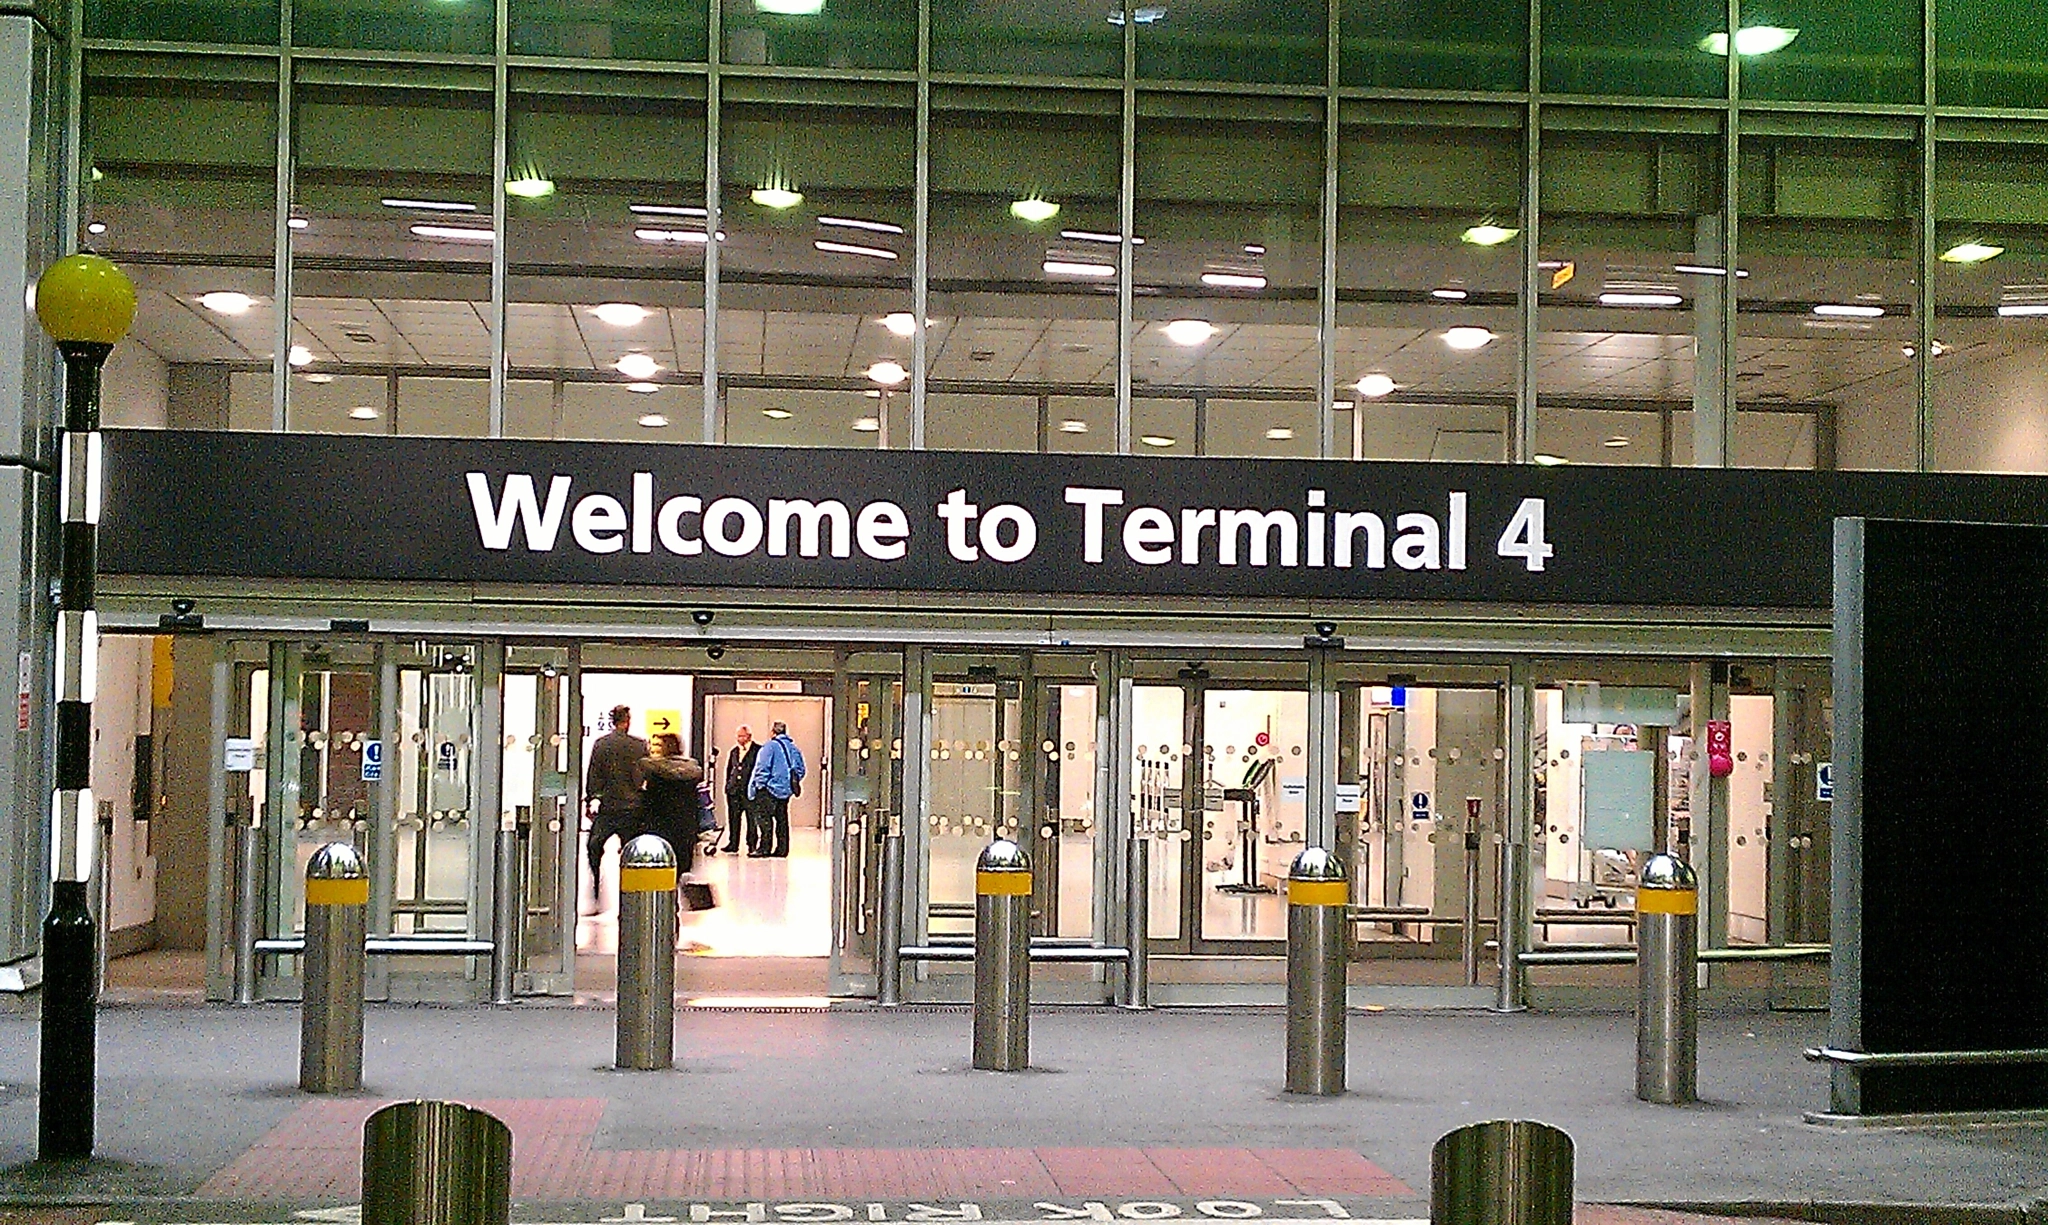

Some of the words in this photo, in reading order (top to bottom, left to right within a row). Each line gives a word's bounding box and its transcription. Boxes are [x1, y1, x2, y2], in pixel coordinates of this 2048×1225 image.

[465, 471, 910, 562] Welcome
[937, 487, 1038, 563] to
[1064, 486, 1468, 571] Terminal
[1497, 497, 1555, 572] 4
[594, 1202, 983, 1223] RIGHT
[1032, 1198, 1352, 1221] LOOK
